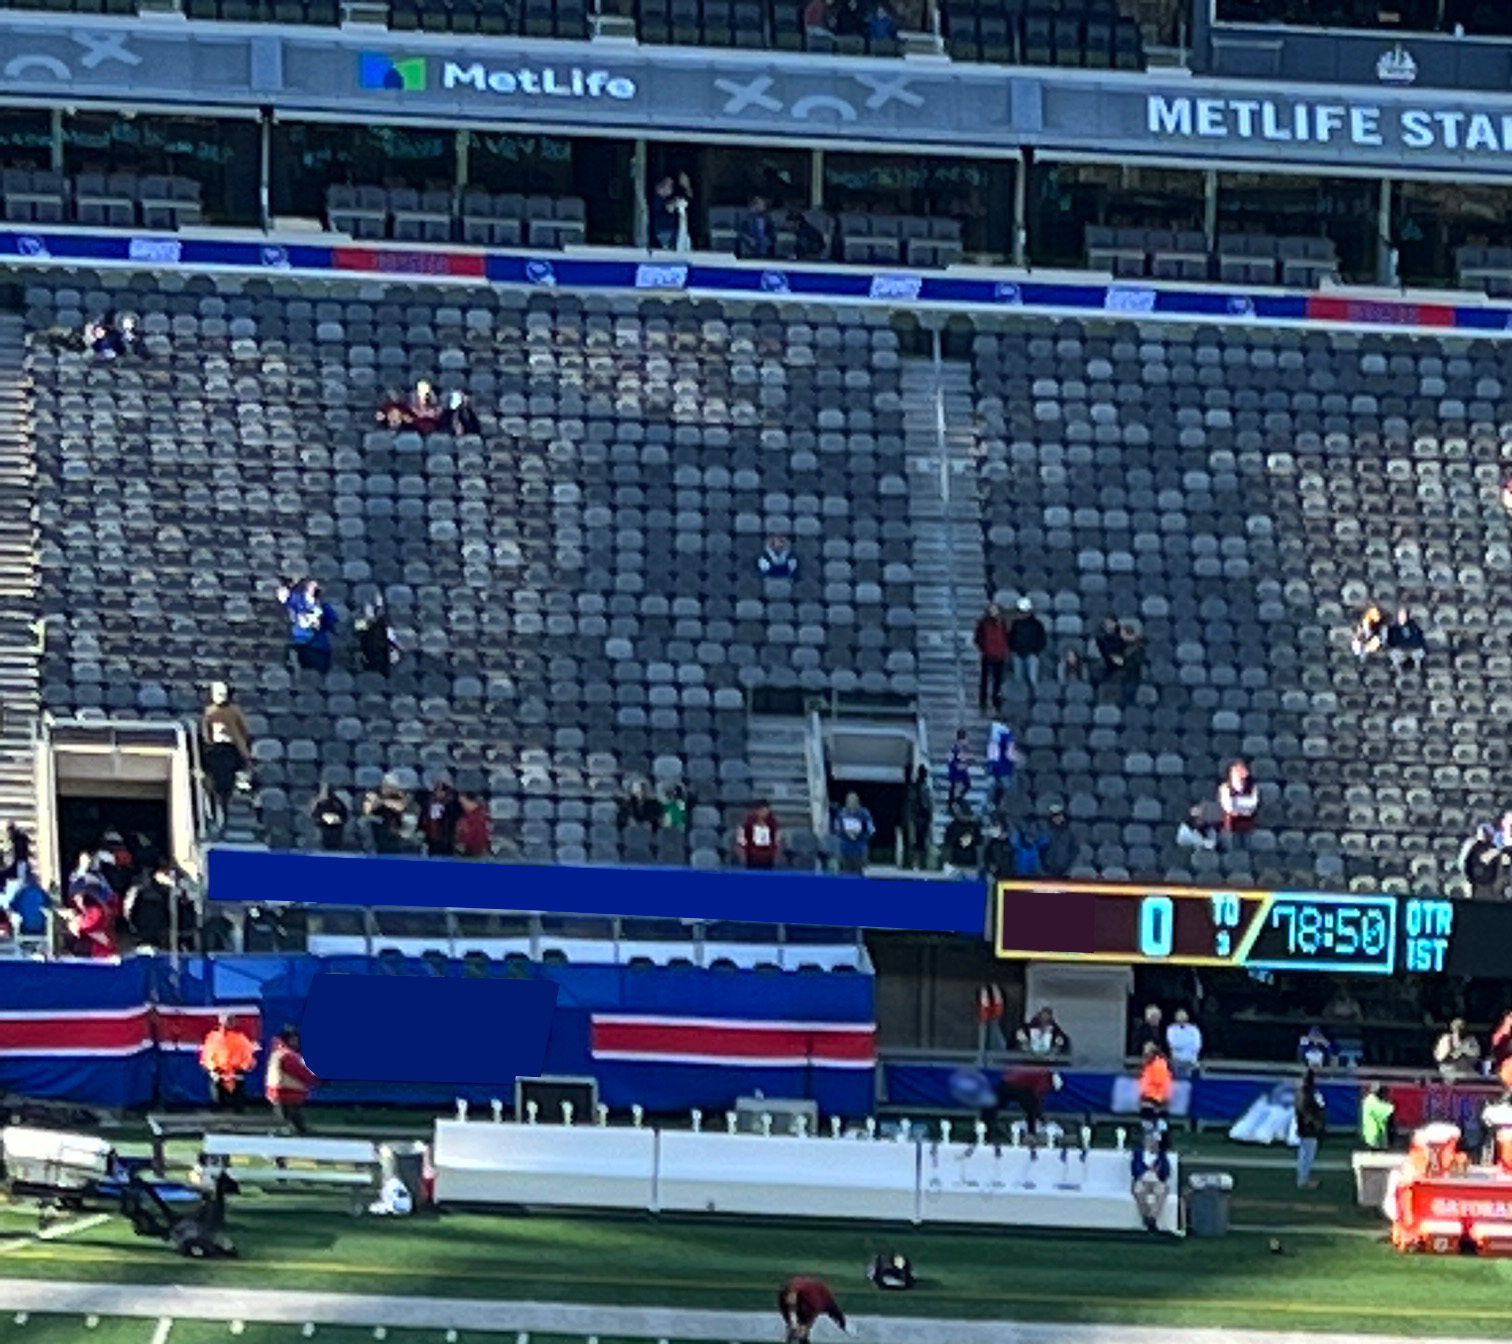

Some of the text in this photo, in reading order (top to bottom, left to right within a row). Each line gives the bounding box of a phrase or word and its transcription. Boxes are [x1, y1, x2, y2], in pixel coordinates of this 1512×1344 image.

[443, 61, 636, 99] MetLife
[1147, 94, 1383, 145] METLIFE
[1141, 896, 1173, 956] 0
